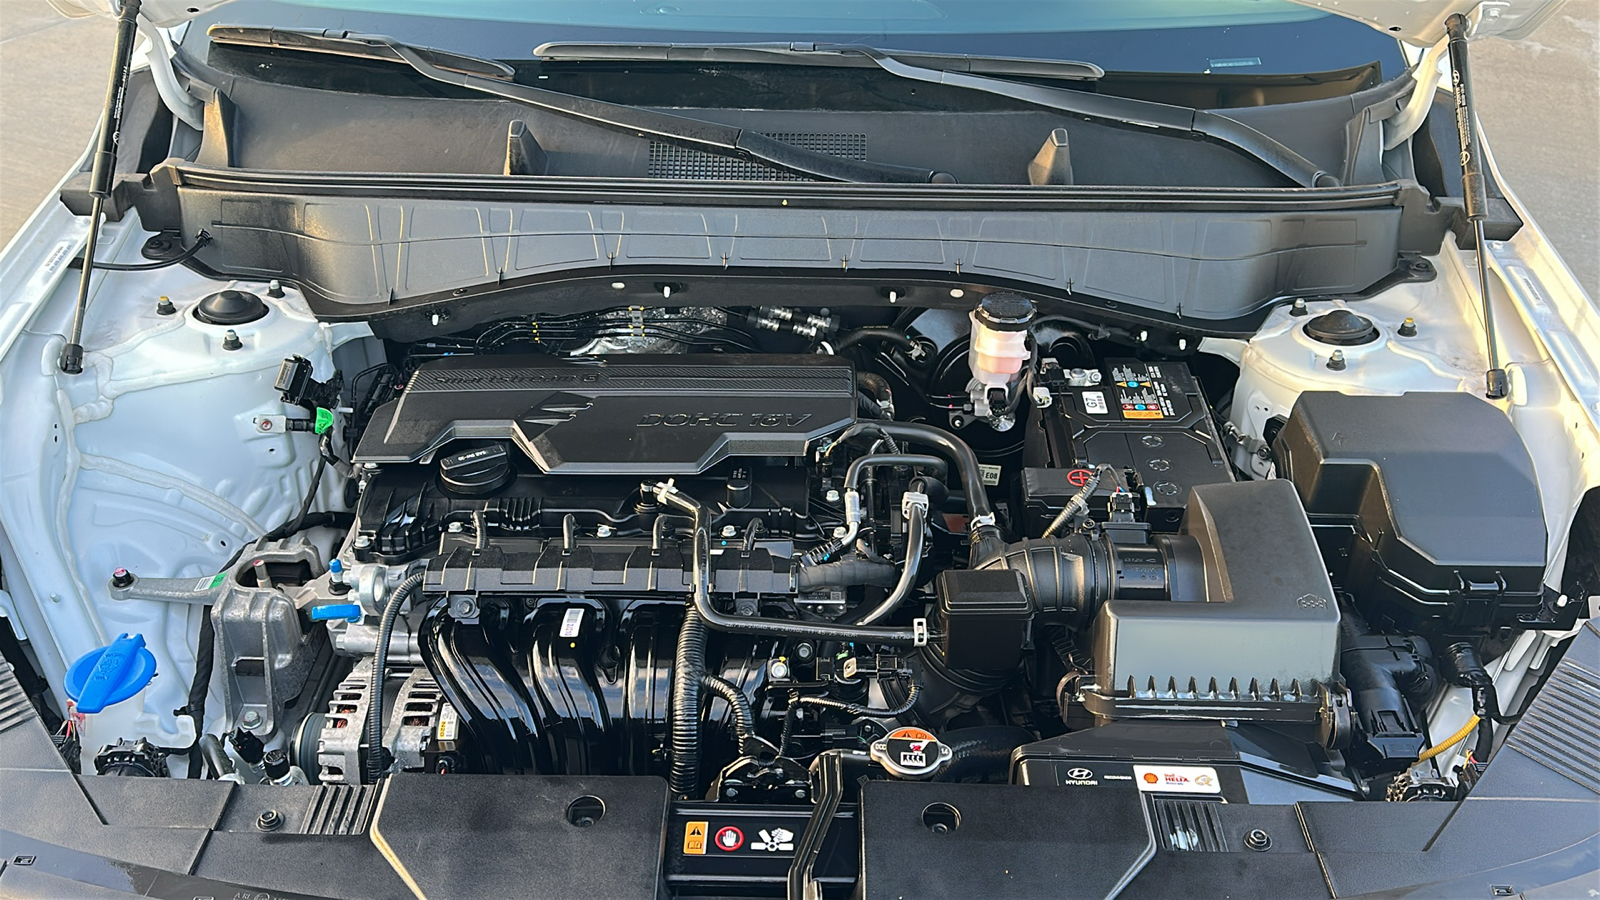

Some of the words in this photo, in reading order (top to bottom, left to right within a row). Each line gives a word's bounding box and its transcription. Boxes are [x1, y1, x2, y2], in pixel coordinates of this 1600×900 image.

[1085, 397, 1098, 408] G7
[636, 412, 743, 427] DOHC
[749, 412, 812, 427] 16V
[985, 471, 998, 480] E08
